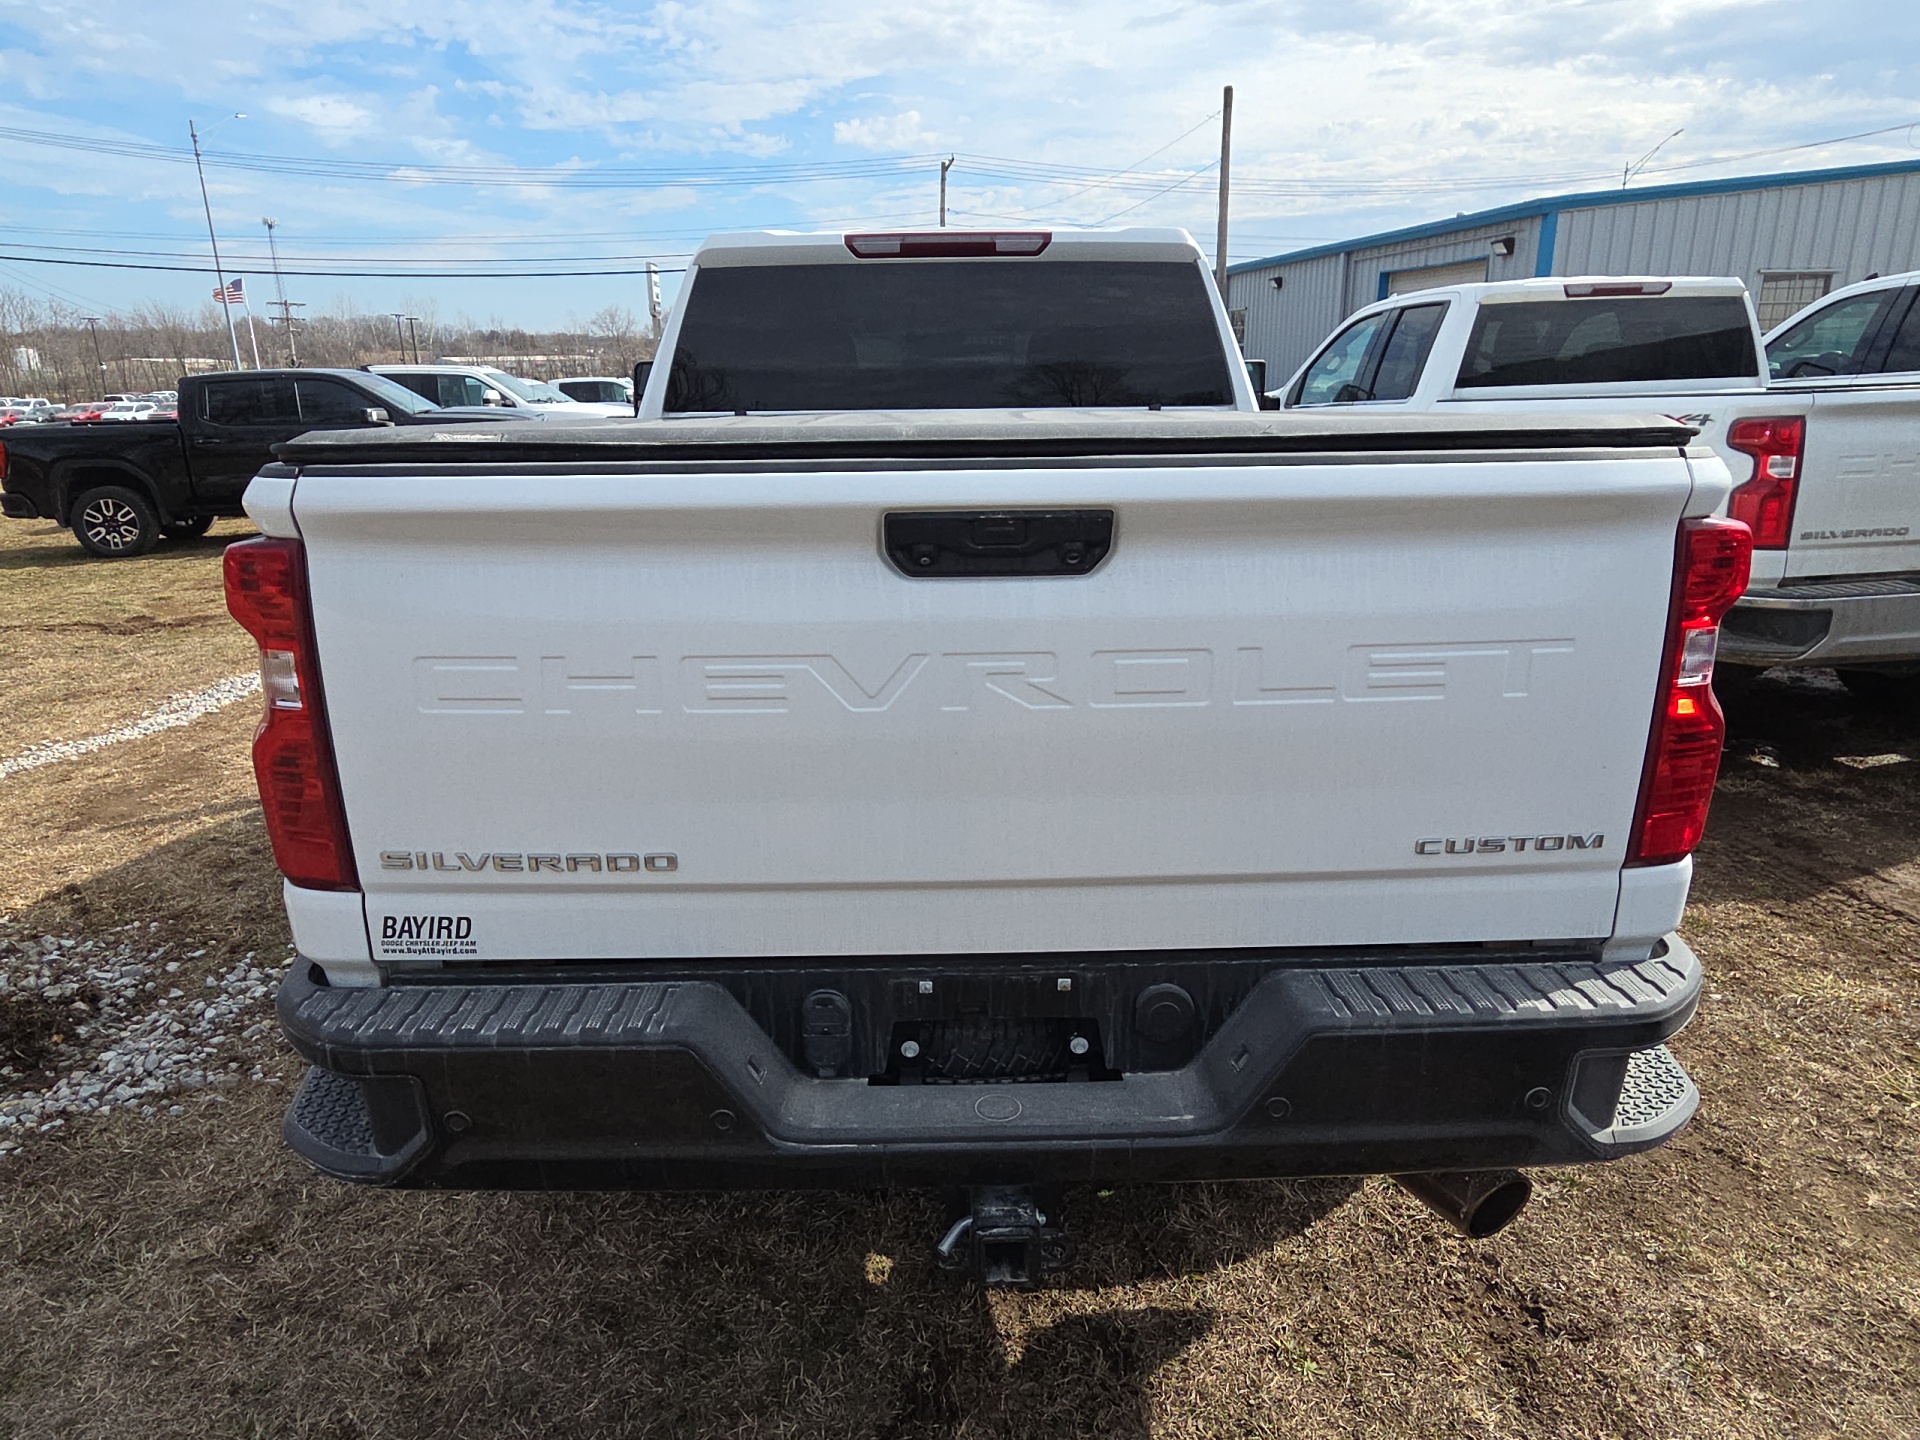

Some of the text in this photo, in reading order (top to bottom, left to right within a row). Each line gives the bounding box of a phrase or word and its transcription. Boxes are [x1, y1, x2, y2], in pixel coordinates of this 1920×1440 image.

[1800, 526, 1910, 541] SILVERADO
[412, 637, 1577, 716] CHEVROLET
[1413, 831, 1606, 856] CUSTOM
[378, 850, 679, 873] SILVERADO
[382, 915, 472, 940] BAYIRD
[382, 946, 478, 956] www.BuyAtBayird.com
